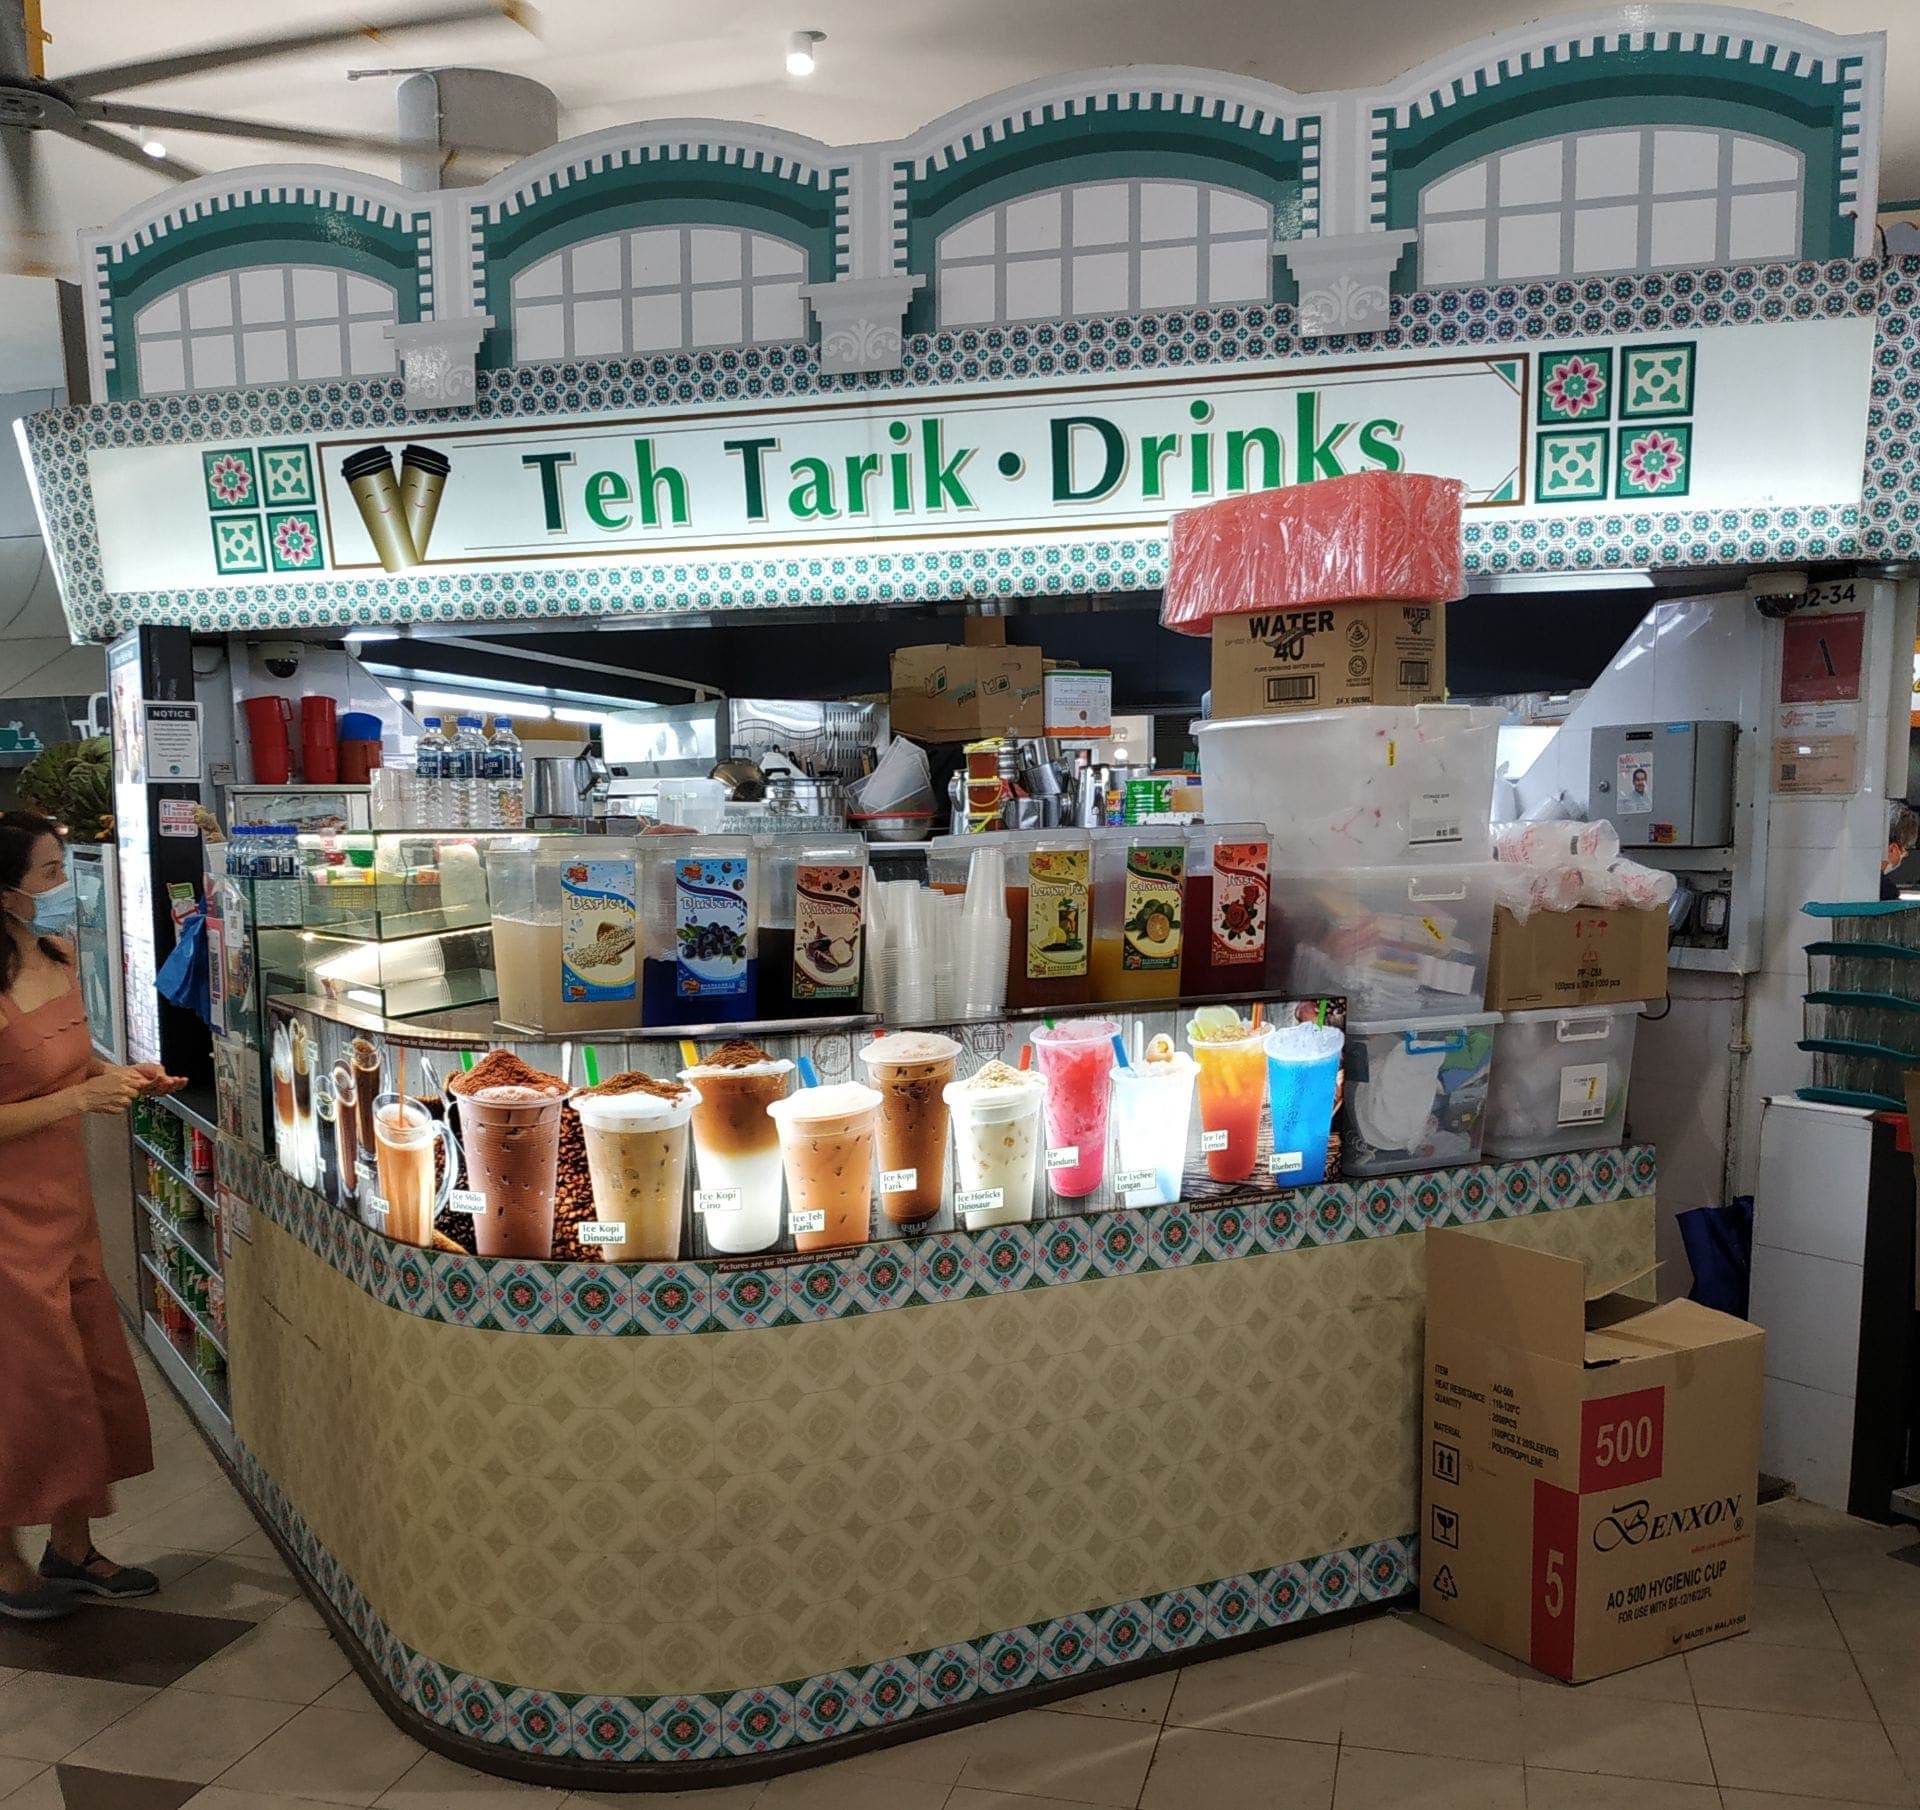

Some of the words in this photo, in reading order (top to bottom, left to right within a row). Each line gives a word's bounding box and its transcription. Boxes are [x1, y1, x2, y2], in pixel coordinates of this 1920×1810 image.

[521, 437, 692, 535] Teh
[724, 417, 978, 523] Tarik
[1050, 391, 1404, 504] Drinks
[1797, 584, 1856, 609] 2-34
[1250, 610, 1335, 639] WATER
[152, 710, 191, 718] NOTICE
[1226, 873, 1254, 888] Rose
[1031, 883, 1066, 897] Lemon
[1068, 882, 1085, 896] Tea
[570, 894, 630, 913] Barley
[681, 896, 746, 910] Blueberry
[1047, 1158, 1077, 1169] Bandung
[897, 1171, 914, 1181] Kopi
[884, 1183, 902, 1191] Tarik
[1117, 1182, 1142, 1192] Longan
[700, 1192, 713, 1200] Ice
[716, 1189, 736, 1200] Kopi
[958, 1194, 970, 1202] Ice
[971, 1190, 1000, 1201] Horlicks
[453, 1202, 485, 1211] Dinosaur
[699, 1201, 721, 1210] Cino
[958, 1201, 991, 1210] Dinosaur
[793, 1214, 806, 1222] Ice
[808, 1212, 823, 1220] Teh
[583, 1224, 597, 1232] Ice
[599, 1223, 620, 1234] Kopi
[792, 1222, 814, 1231] Tarik
[583, 1233, 624, 1242] Dinosaur
[718, 1262, 749, 1271] Pictures
[815, 1250, 843, 1261] propose
[1435, 1363, 1448, 1376] ITEM
[1595, 1415, 1653, 1467] 500
[1491, 1442, 1544, 1468] POLYPROPYLENE
[1545, 1548, 1564, 1618] 5
[1606, 1589, 1625, 1611] AO
[1626, 1583, 1647, 1605] 500
[1647, 1566, 1702, 1598] HYGIENIC
[1703, 1559, 1727, 1582] CUP
[1618, 1609, 1633, 1624] FOR
[1633, 1606, 1649, 1620] USE
[1650, 1600, 1667, 1615] WITH
[1684, 1625, 1704, 1641] MADE
[1705, 1622, 1713, 1634] IN
